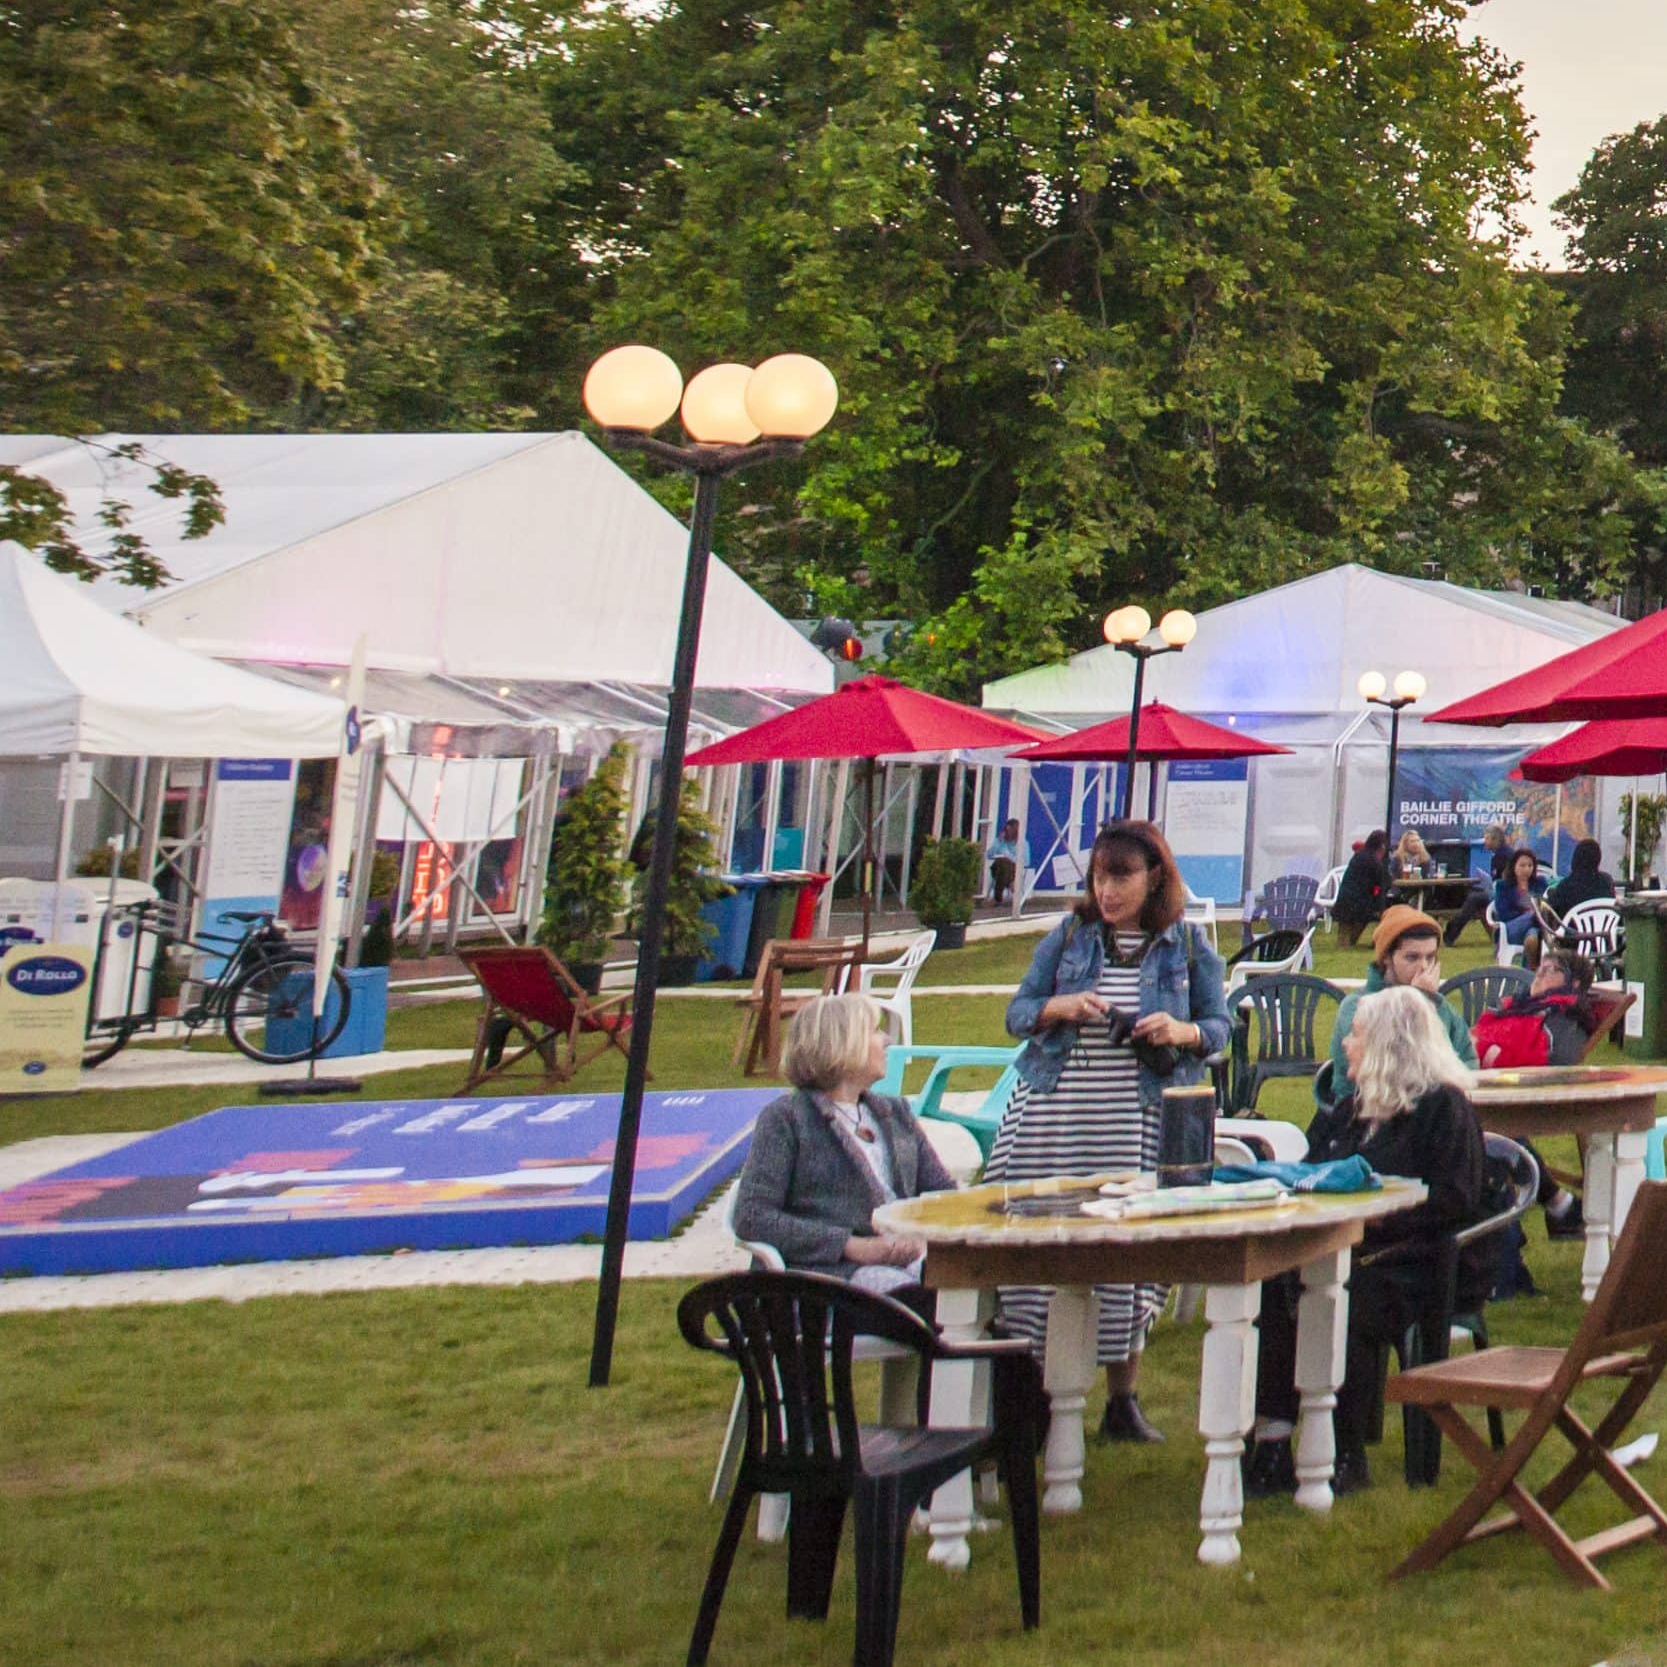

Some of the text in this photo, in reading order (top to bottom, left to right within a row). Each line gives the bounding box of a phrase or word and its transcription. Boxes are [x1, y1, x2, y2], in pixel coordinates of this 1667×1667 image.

[1400, 801, 1516, 813] BAILLIE GIFFORD
[1400, 813, 1525, 825] CORNER THEATRE
